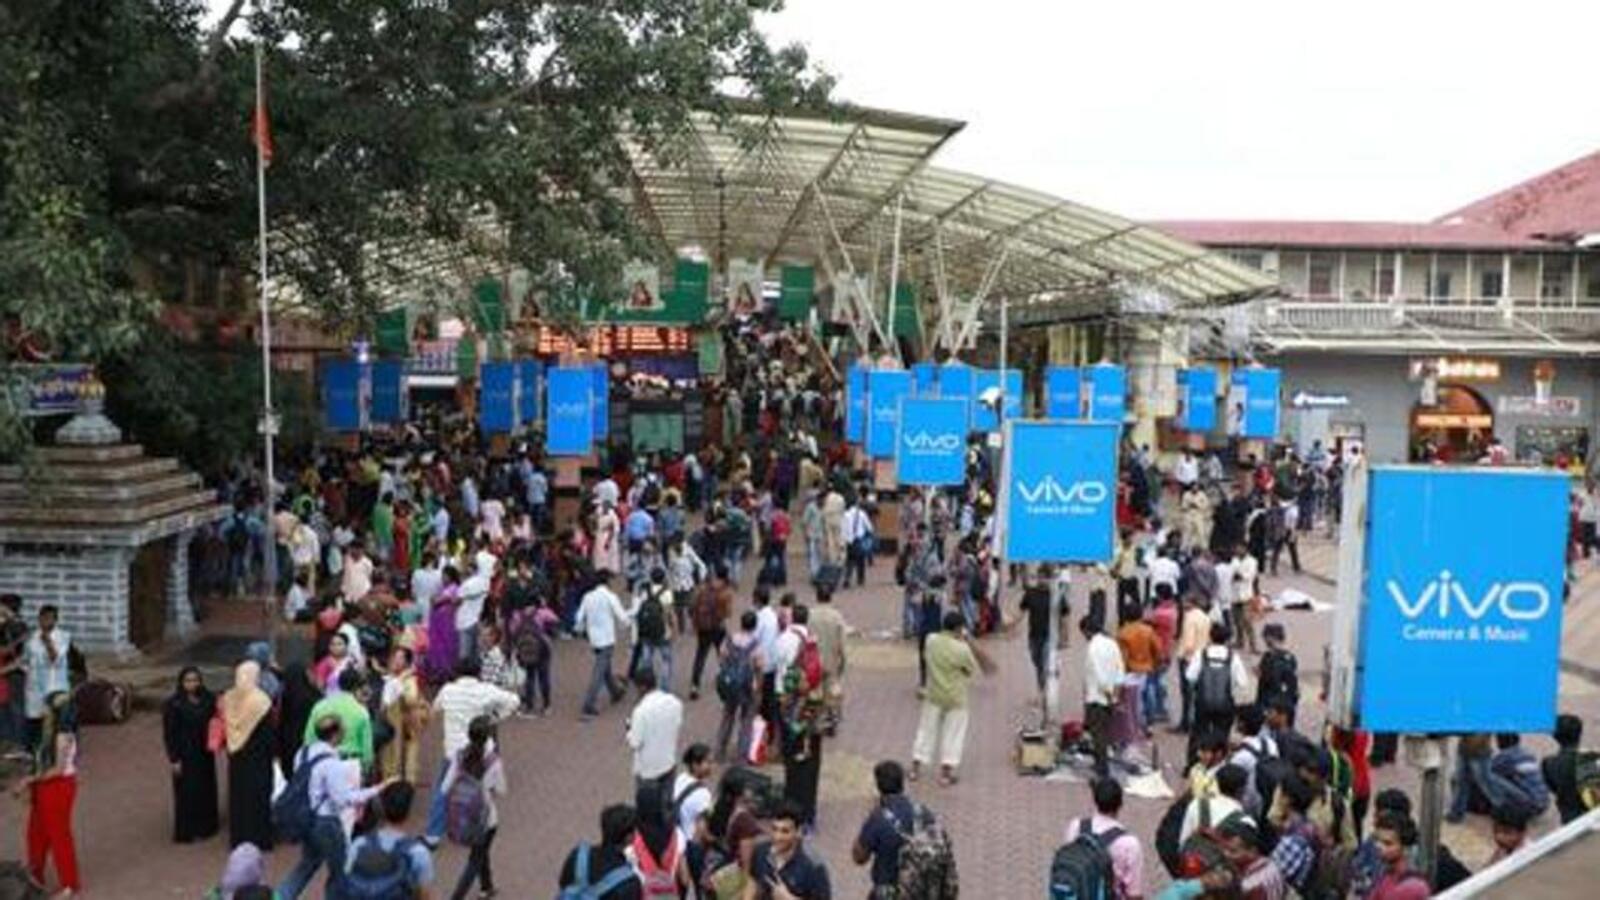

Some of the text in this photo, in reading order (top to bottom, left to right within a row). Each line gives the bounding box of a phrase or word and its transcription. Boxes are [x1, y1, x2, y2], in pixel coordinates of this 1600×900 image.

[903, 431, 961, 449] vivo
[1017, 475, 1108, 503] vivo
[1387, 569, 1550, 619] vivo
